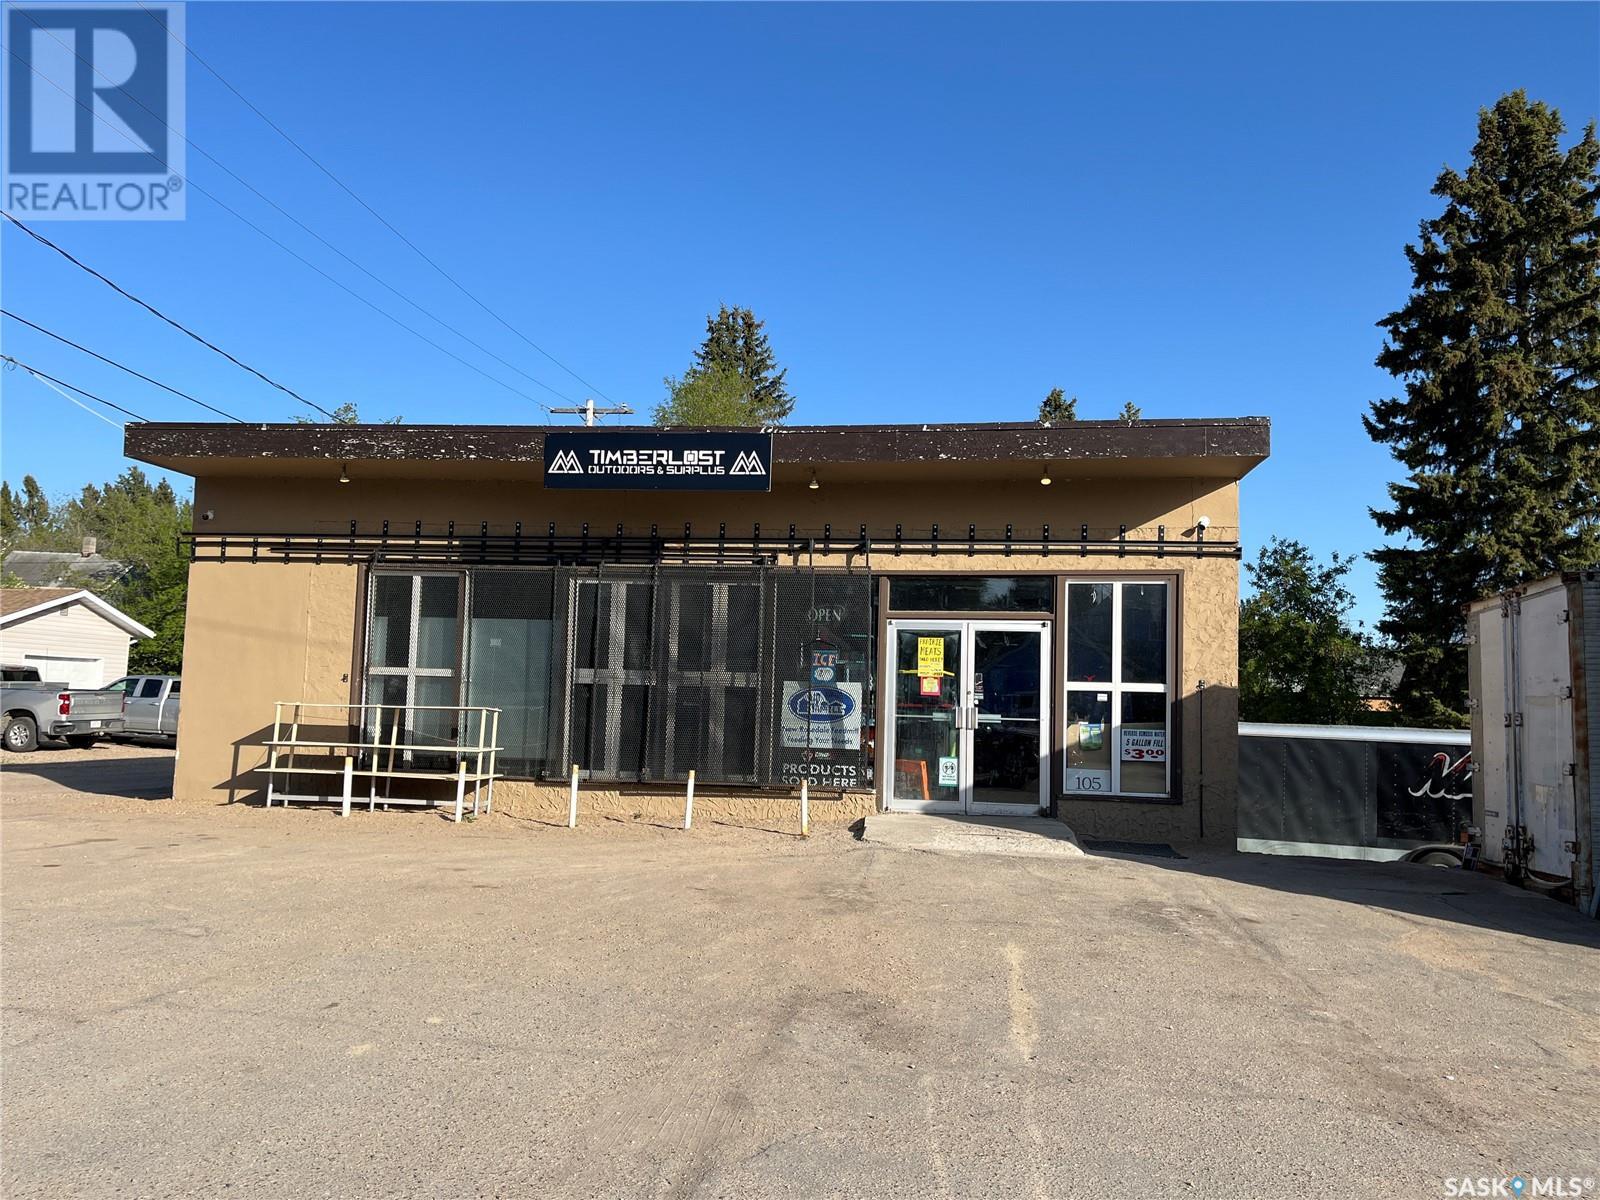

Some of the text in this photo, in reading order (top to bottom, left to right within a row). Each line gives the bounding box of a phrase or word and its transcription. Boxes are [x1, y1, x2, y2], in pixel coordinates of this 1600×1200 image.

[589, 449, 726, 466] TIMBERLOST
[588, 465, 726, 476] OUTDOORS & SURPLUS
[807, 607, 842, 621] OPEN
[919, 646, 942, 656] MEATS
[813, 652, 836, 666] ICE
[1126, 738, 1164, 747] 5 GALLON FILL
[783, 764, 857, 777] PRODUCTS
[782, 776, 857, 788] SOD HERE
[1075, 777, 1102, 790] 105
